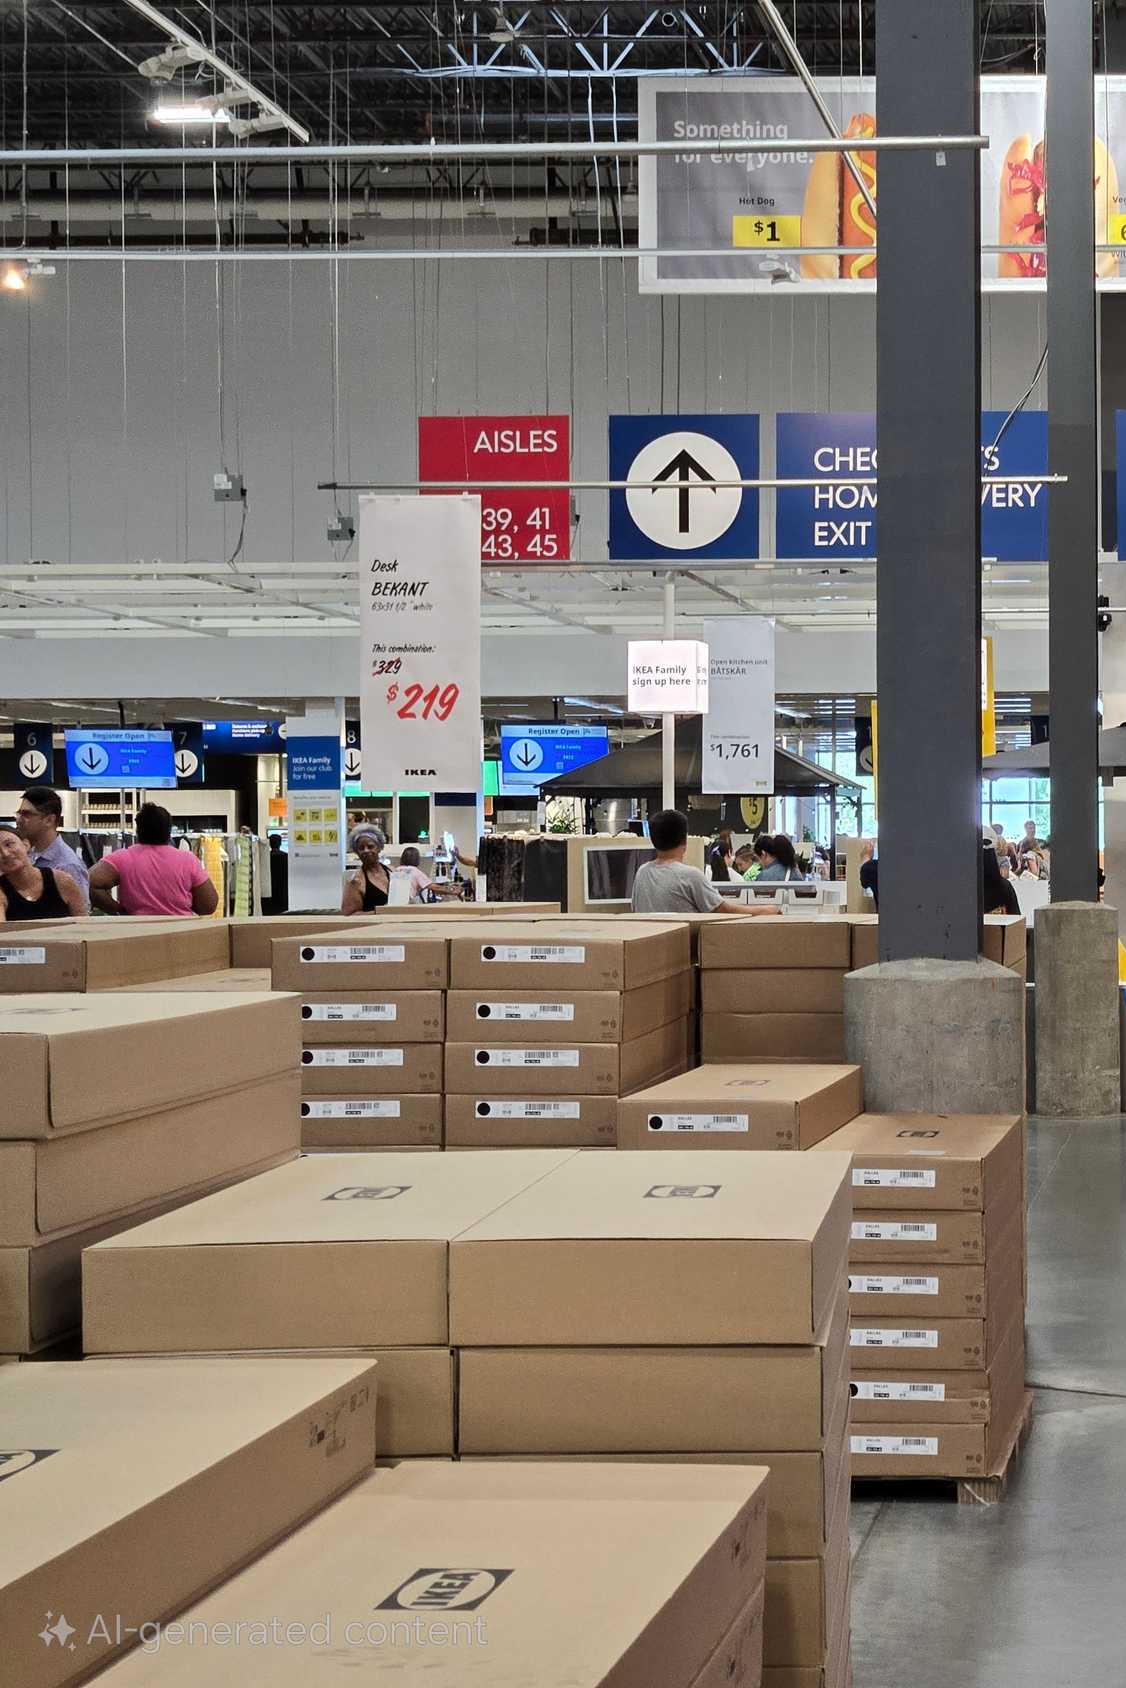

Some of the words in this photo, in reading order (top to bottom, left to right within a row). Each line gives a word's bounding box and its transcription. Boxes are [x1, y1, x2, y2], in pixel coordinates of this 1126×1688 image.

[673, 120, 788, 139] Something
[739, 197, 755, 205] Hot
[757, 197, 775, 207] Dog
[754, 220, 780, 242] $1
[473, 430, 558, 453] AISLES
[814, 485, 877, 509] HOM
[482, 508, 518, 533] 39,
[526, 507, 550, 530] 41
[814, 521, 872, 546] EXIT
[481, 534, 519, 559] 43,
[526, 534, 558, 557] 45
[371, 559, 398, 573] Desk
[371, 581, 429, 597] BEKANT
[371, 643, 387, 653] This
[633, 666, 653, 674] IKEA
[655, 665, 687, 676] Family
[632, 678, 652, 687] sign
[655, 679, 667, 687] up
[669, 677, 691, 686] here
[386, 682, 460, 722] $219
[27, 731, 37, 747] 6
[124, 732, 145, 740] Open
[177, 731, 188, 745] 7
[347, 730, 357, 744] 8
[528, 728, 559, 736] Register
[560, 728, 580, 736] Open
[710, 743, 759, 760] $1,761
[308, 757, 332, 765] Family
[410, 1572, 481, 1606] IKEA
